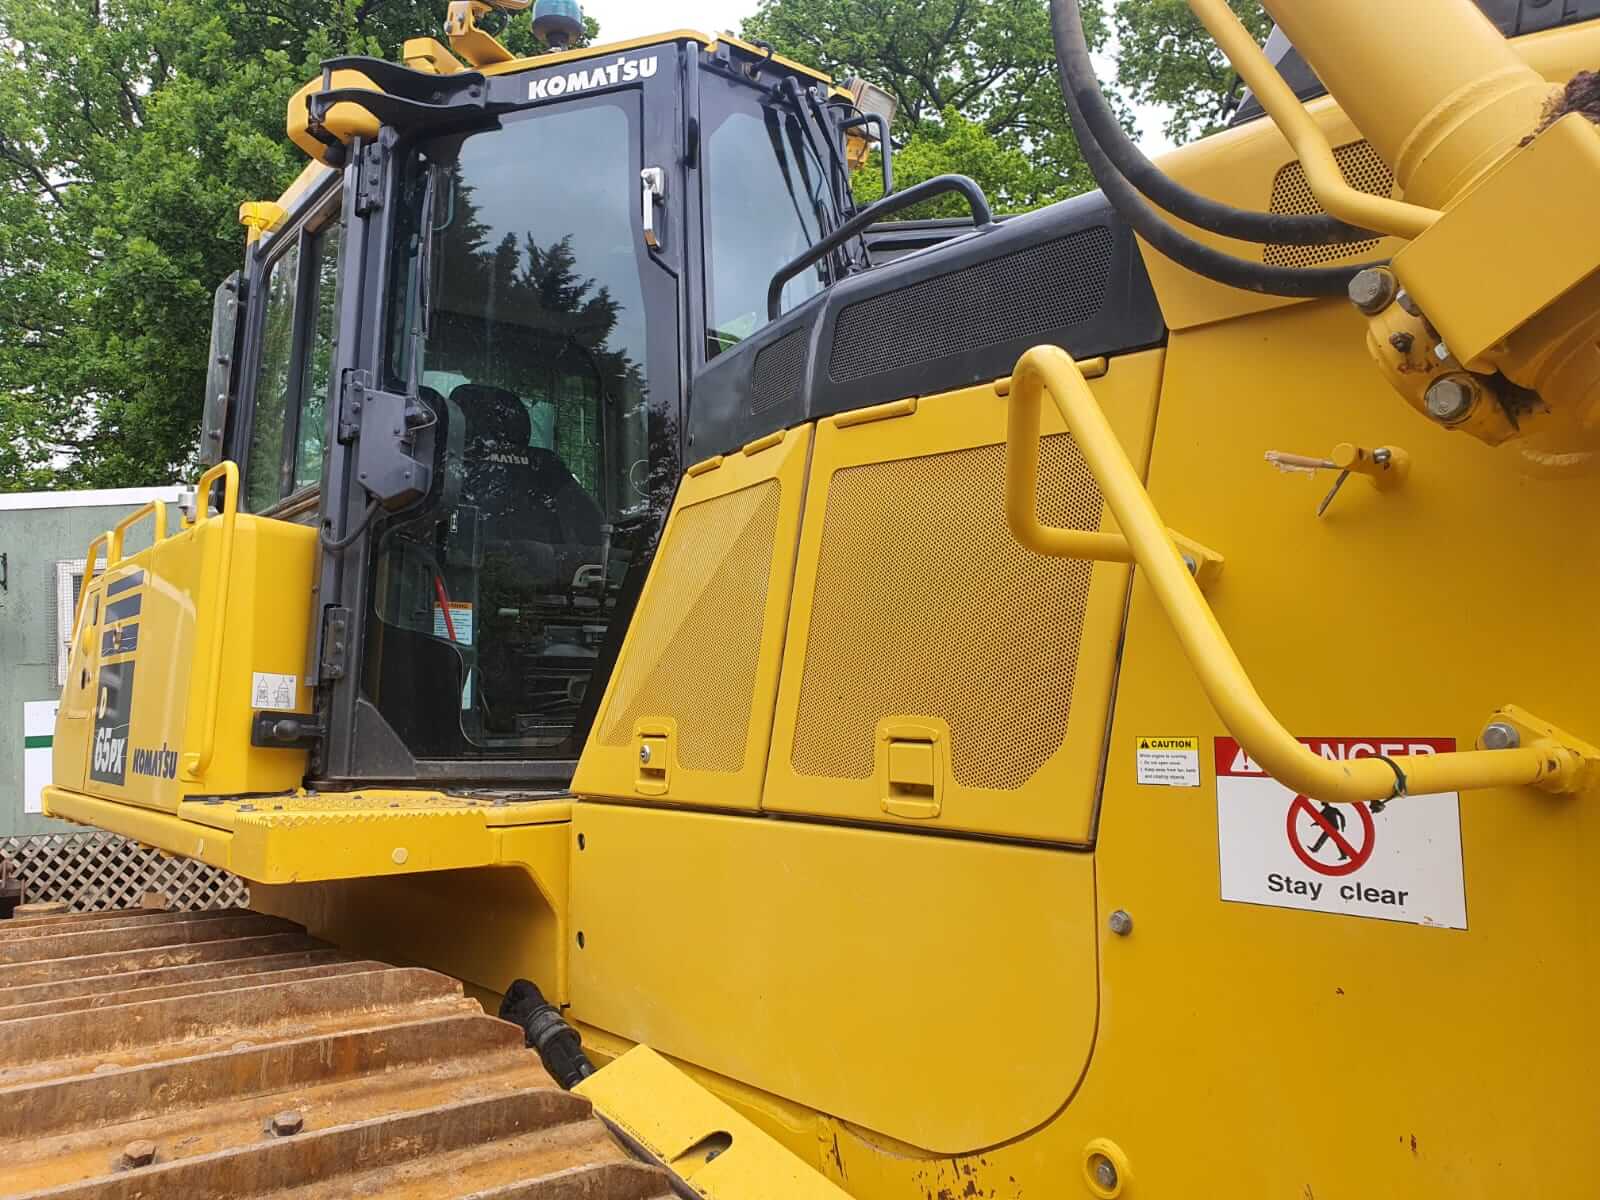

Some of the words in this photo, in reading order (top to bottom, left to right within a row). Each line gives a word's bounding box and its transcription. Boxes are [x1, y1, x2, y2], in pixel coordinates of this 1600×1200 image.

[527, 55, 658, 100] KOMATSU
[94, 727, 125, 774] 65PX
[132, 742, 178, 780] KOMATSU
[1151, 740, 1192, 748] CAUTION
[1267, 873, 1323, 901] Stay
[1340, 882, 1409, 906] clear
